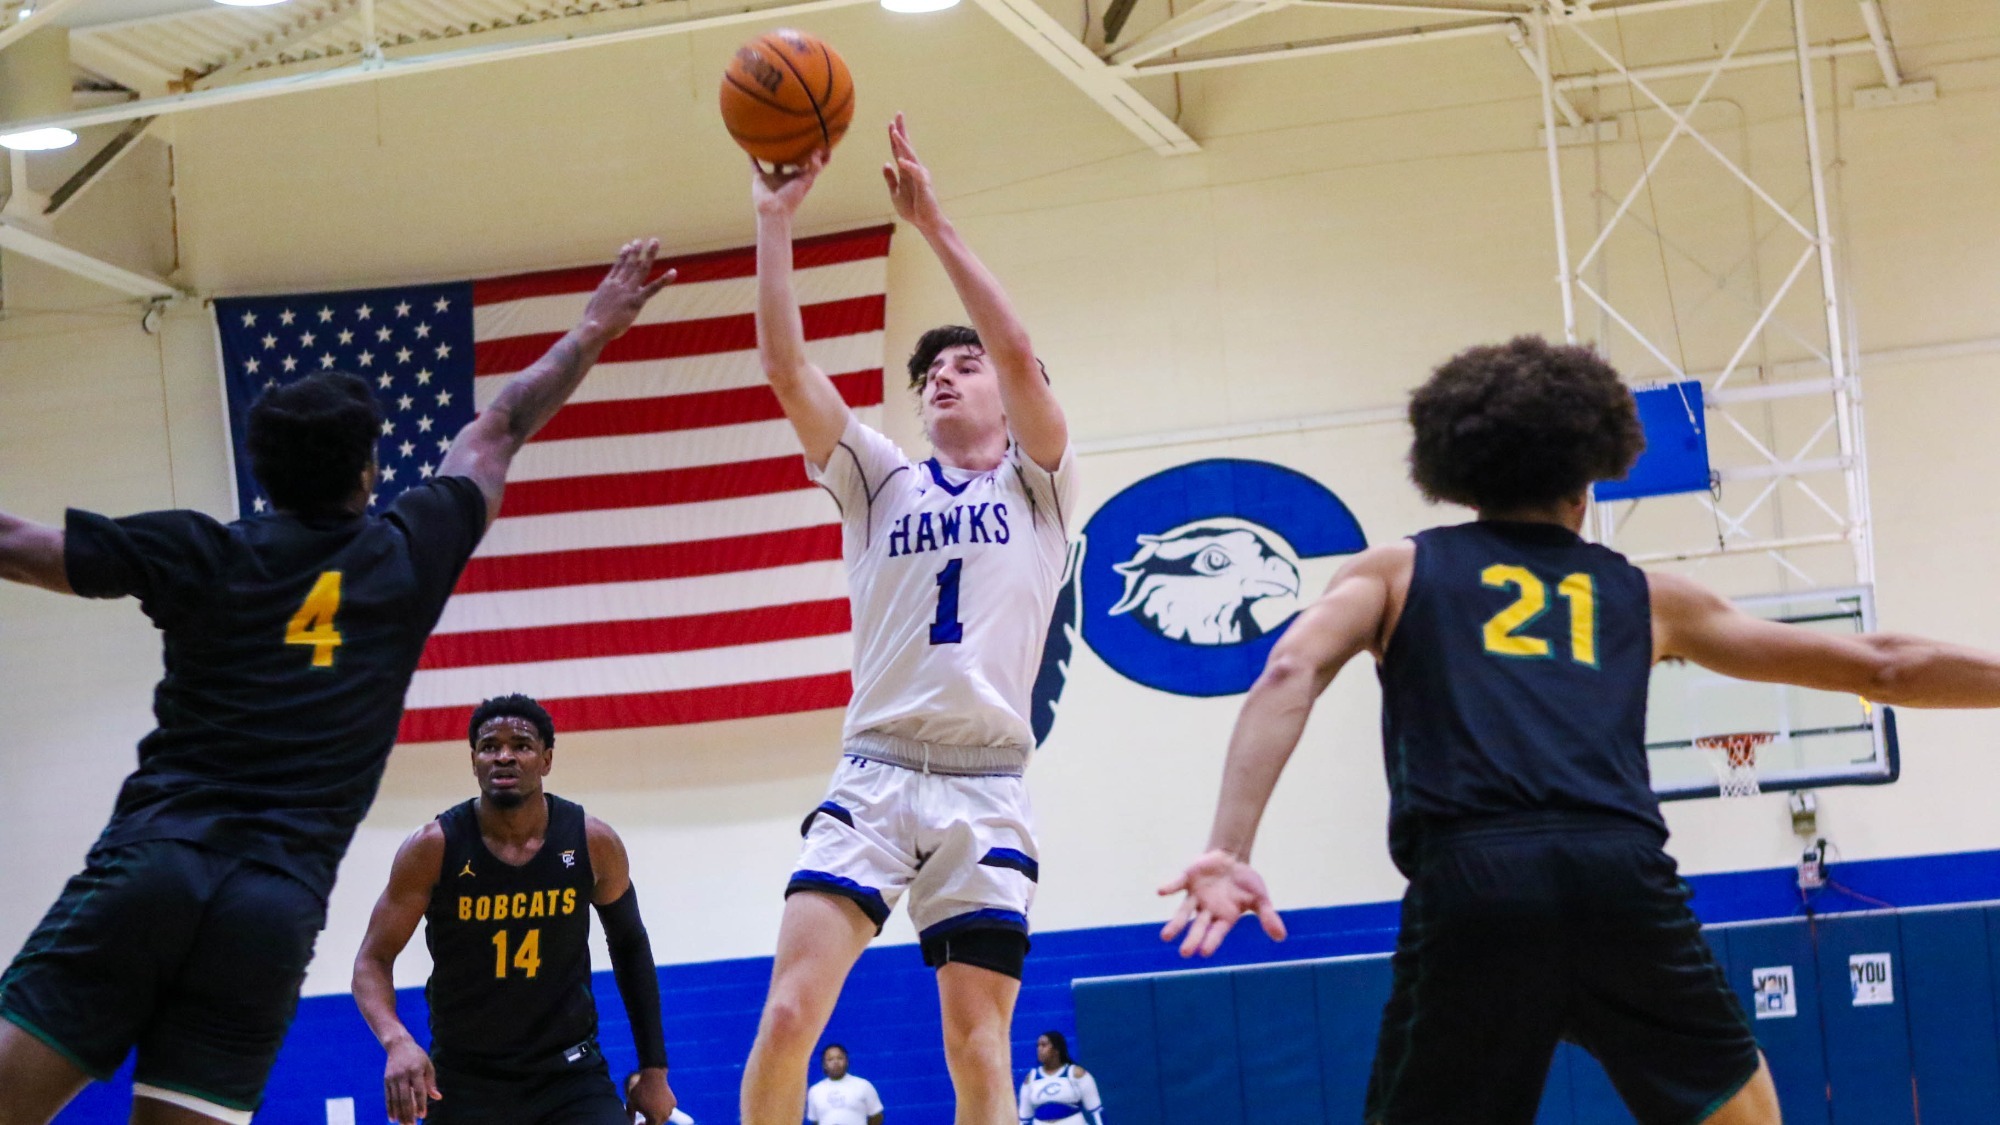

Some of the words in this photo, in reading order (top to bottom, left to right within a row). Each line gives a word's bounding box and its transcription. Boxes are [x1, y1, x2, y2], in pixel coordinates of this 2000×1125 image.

[888, 502, 1010, 557] HAWKS
[284, 570, 343, 667] 4
[929, 558, 963, 645] 1
[1480, 563, 1598, 667] 21
[458, 887, 577, 921] BOBCATS
[492, 929, 541, 978] 14
[1857, 961, 1886, 983] YOU
